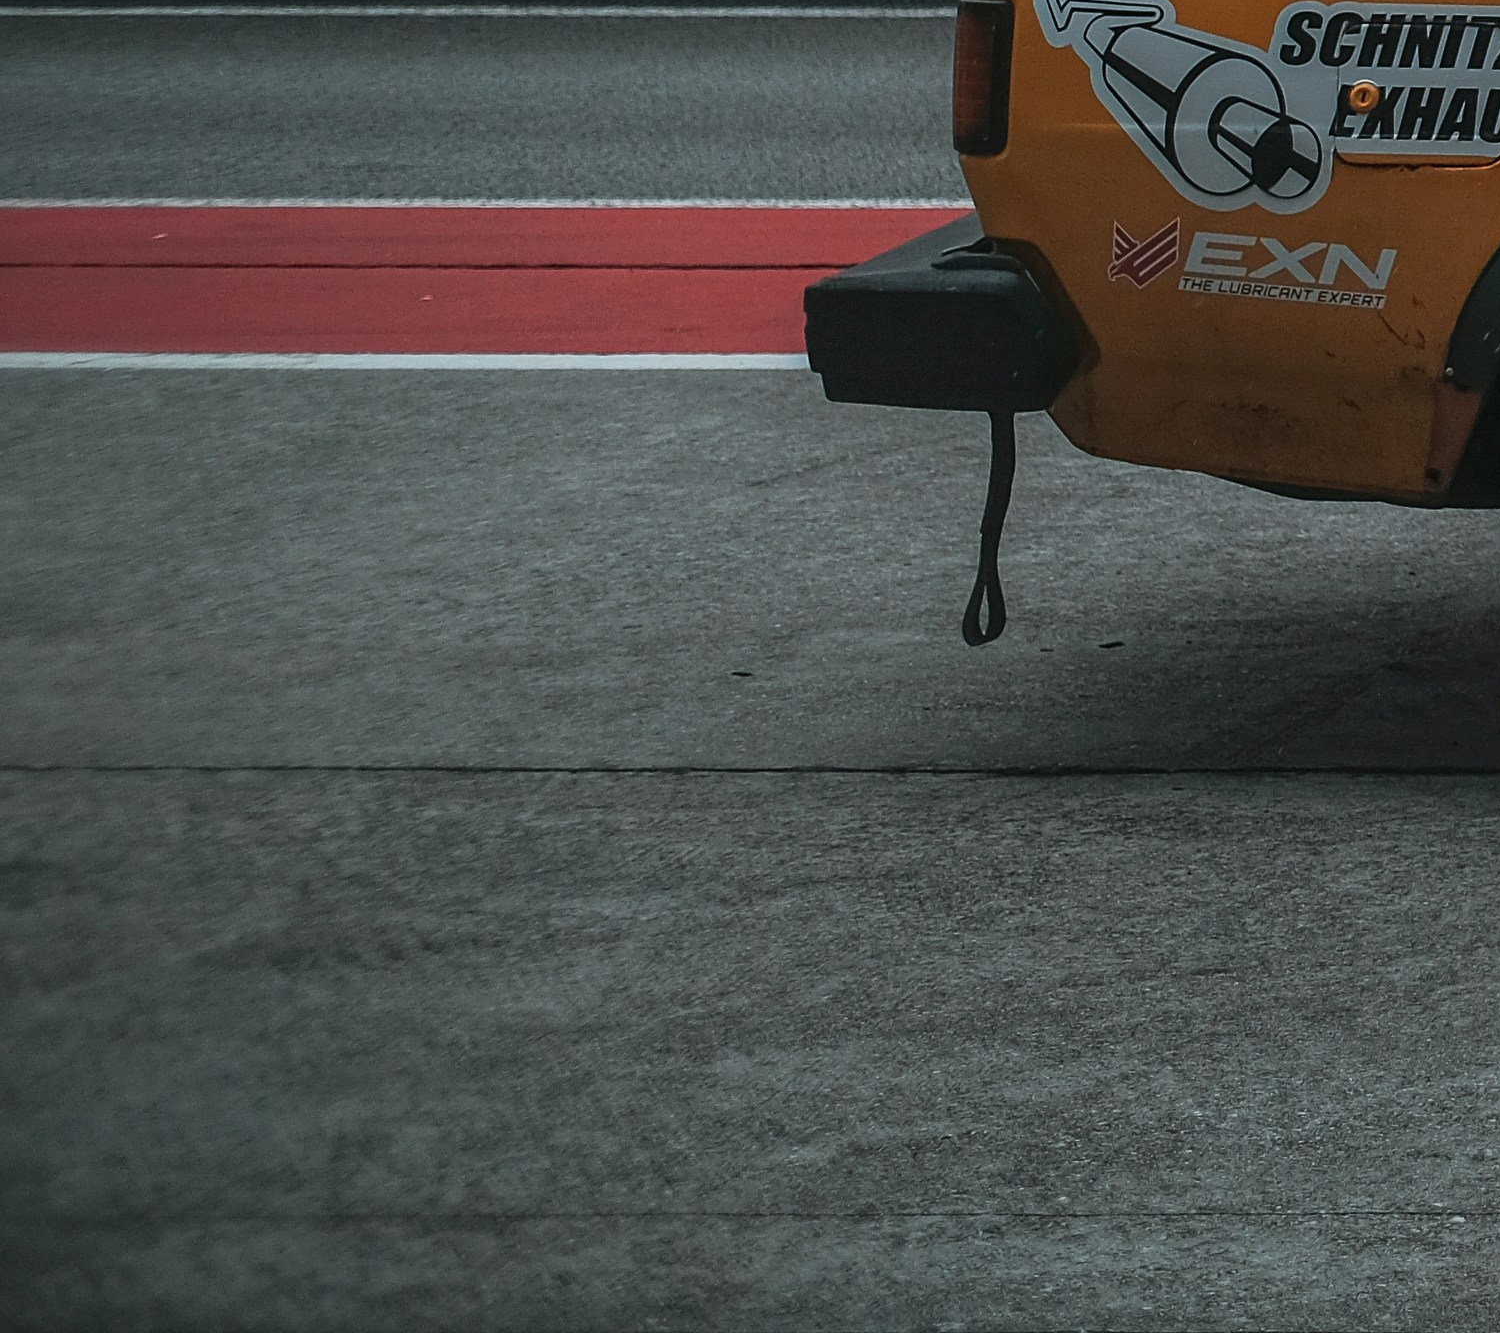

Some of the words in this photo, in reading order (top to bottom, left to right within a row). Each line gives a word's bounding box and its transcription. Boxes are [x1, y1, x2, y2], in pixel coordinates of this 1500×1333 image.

[1183, 231, 1398, 290] EXN
[1181, 276, 1213, 293] THE
[1218, 281, 1313, 303] LUBRICANT
[1317, 289, 1386, 309] EXPERT
